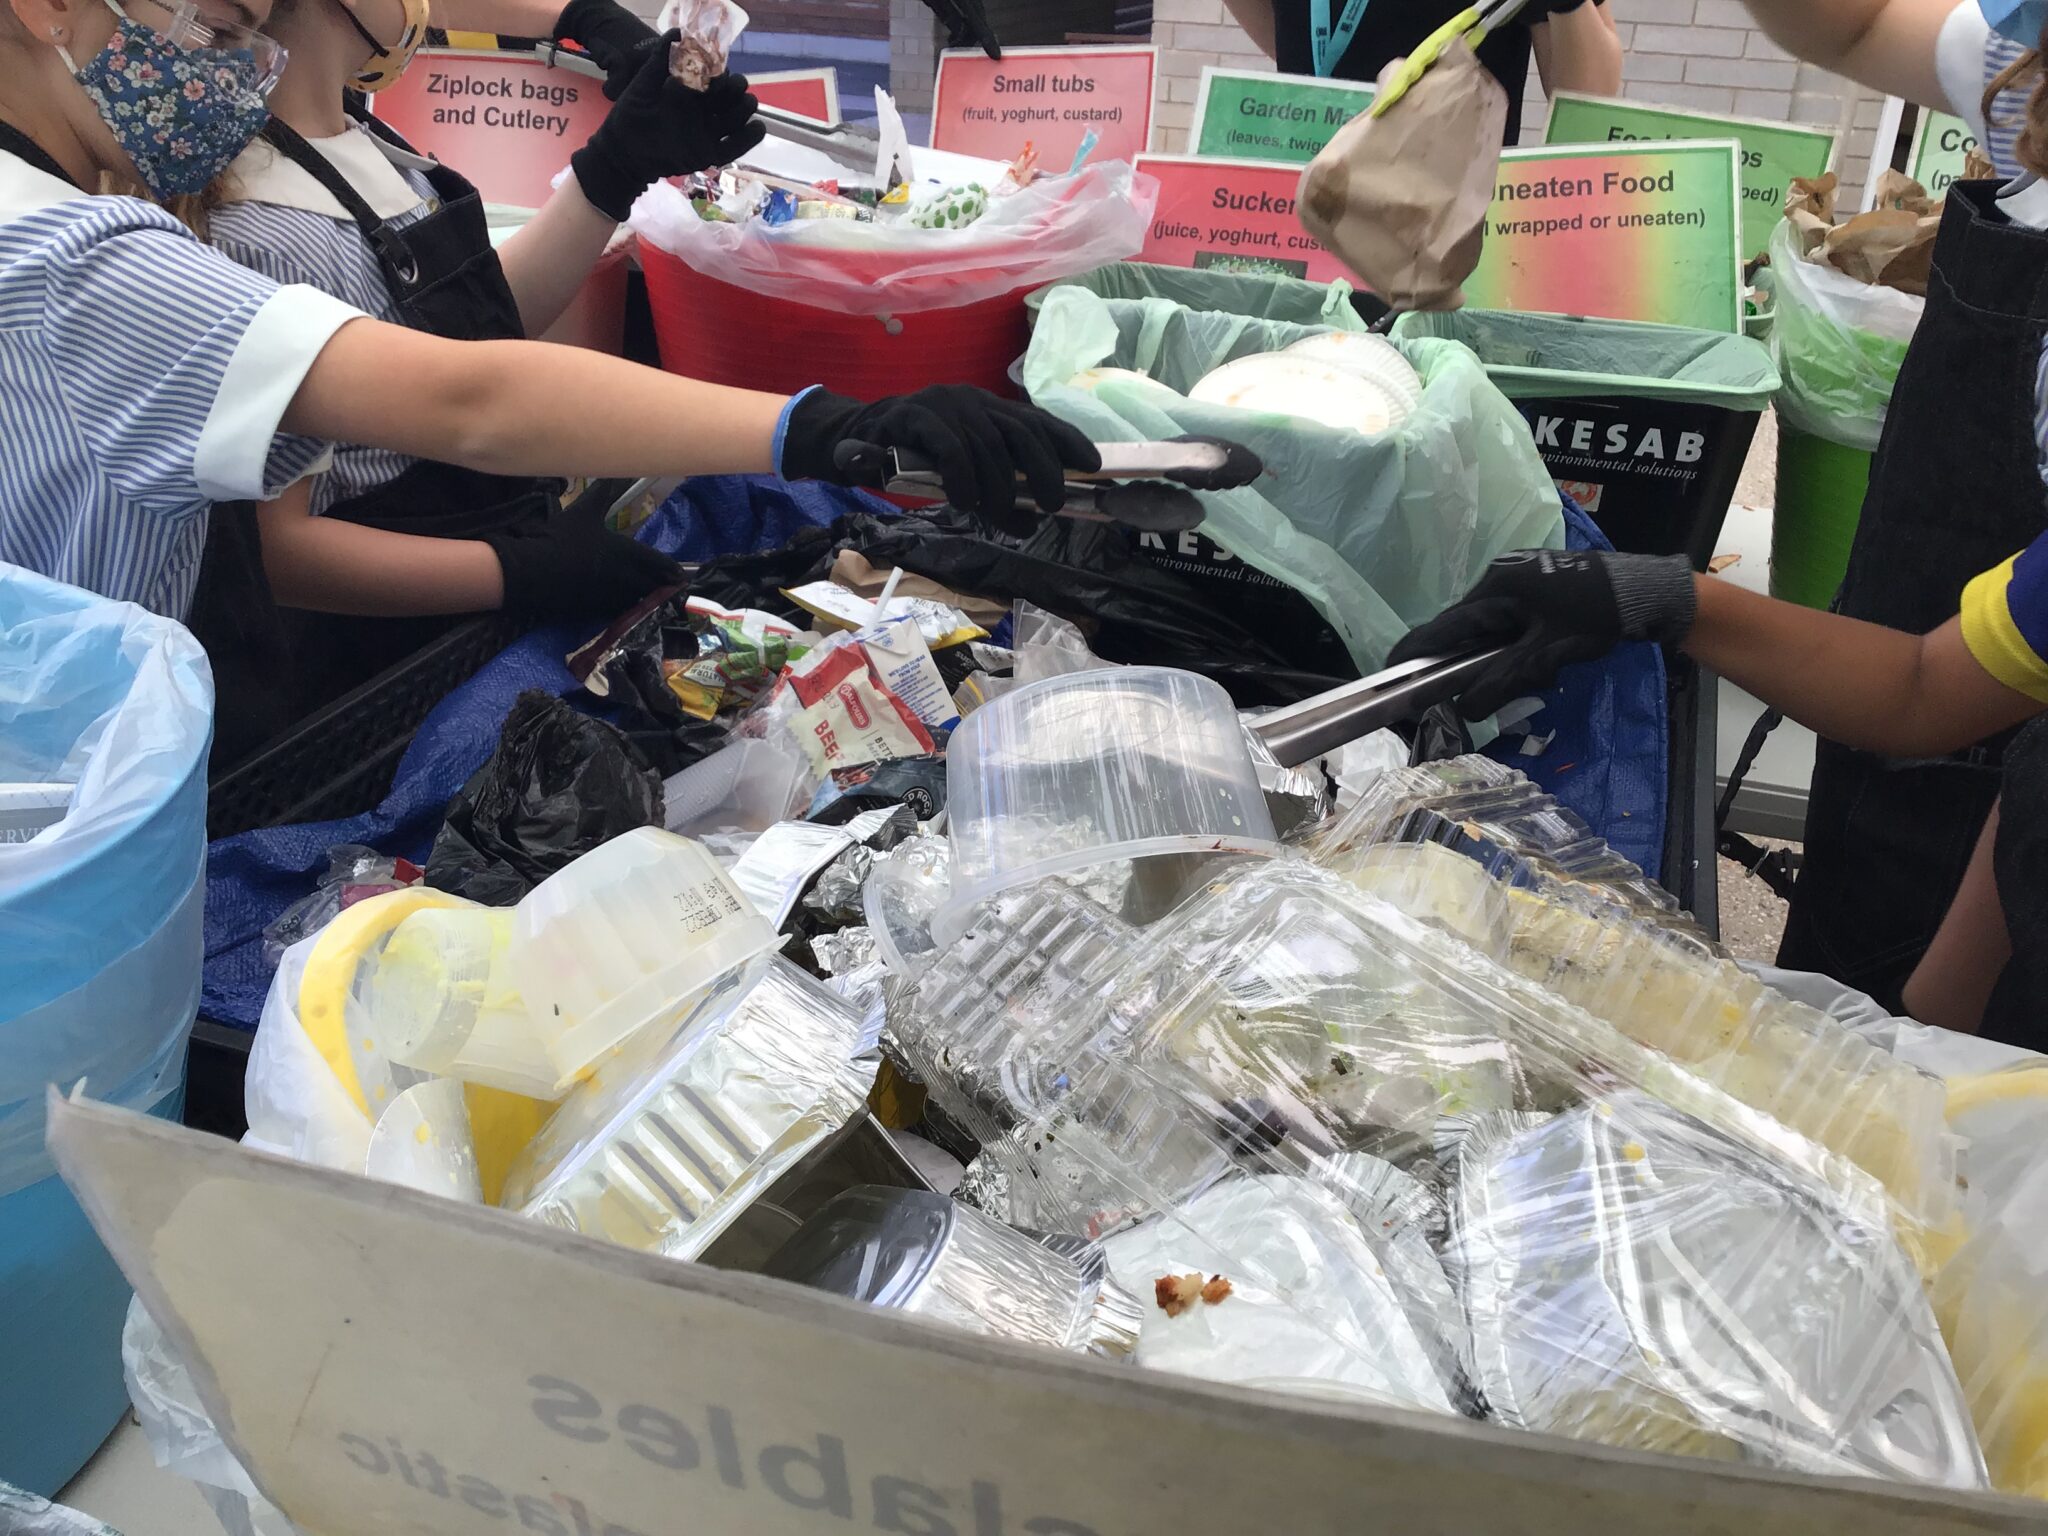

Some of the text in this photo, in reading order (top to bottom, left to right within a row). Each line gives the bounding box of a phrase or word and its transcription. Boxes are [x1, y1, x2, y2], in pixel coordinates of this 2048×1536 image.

[427, 73, 579, 106] Ziplock bags
[993, 74, 1095, 93] Small tubs
[433, 105, 570, 137] and Cutlery
[962, 107, 1122, 124] (fruit, yoghurt, custard)
[1240, 97, 1316, 123] Garden
[1226, 129, 1284, 149] (leaves,
[1491, 170, 1675, 202] neaten Food
[1153, 220, 1203, 242] (juice,
[1208, 228, 1281, 249] yoghurt,
[1496, 213, 1583, 237] wrapped
[1589, 214, 1611, 229] or
[1617, 208, 1706, 229] uneaten)
[1534, 415, 1706, 463] KESAB
[1538, 451, 1698, 480] nvironmental solutions
